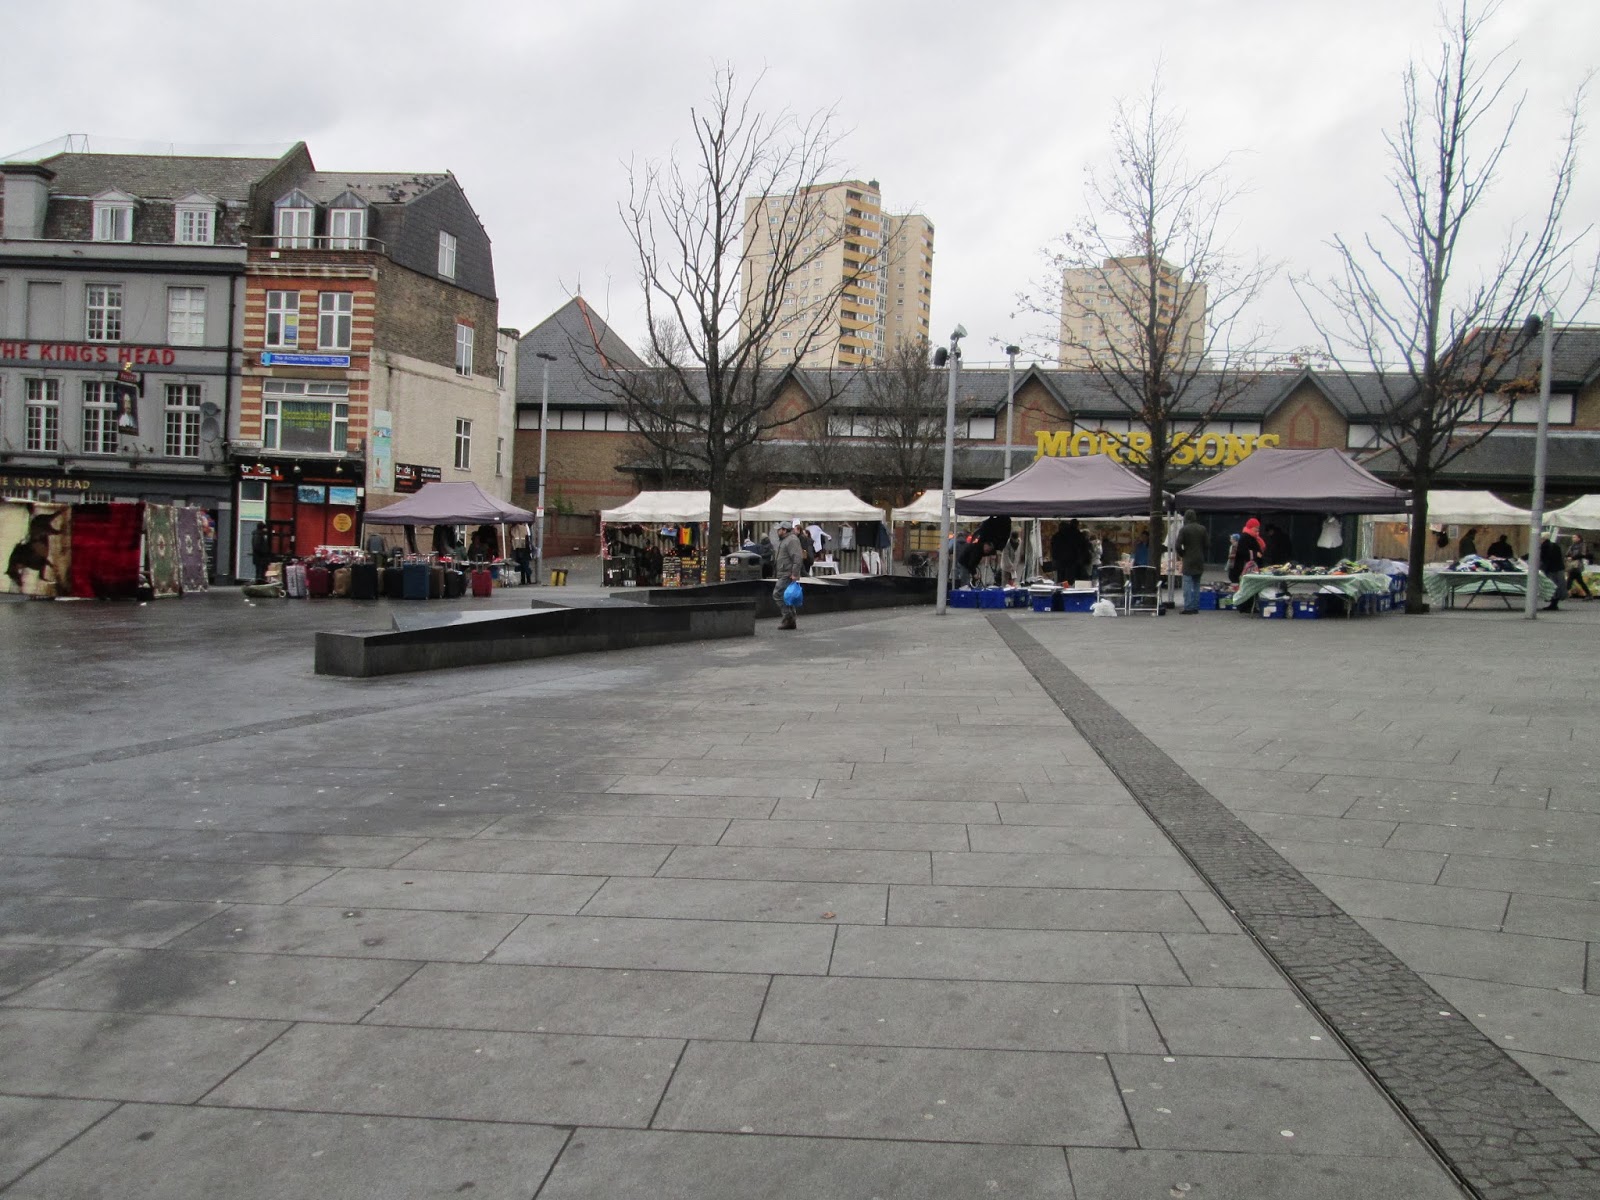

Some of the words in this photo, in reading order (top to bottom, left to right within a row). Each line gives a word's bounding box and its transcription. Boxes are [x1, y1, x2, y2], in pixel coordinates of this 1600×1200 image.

[0, 342, 29, 360] HE
[40, 343, 108, 363] KINGS
[118, 346, 176, 366] HEAD
[1034, 430, 1280, 466] MORRSON
[15, 477, 52, 488] KINGS
[57, 479, 91, 489] HEAD
